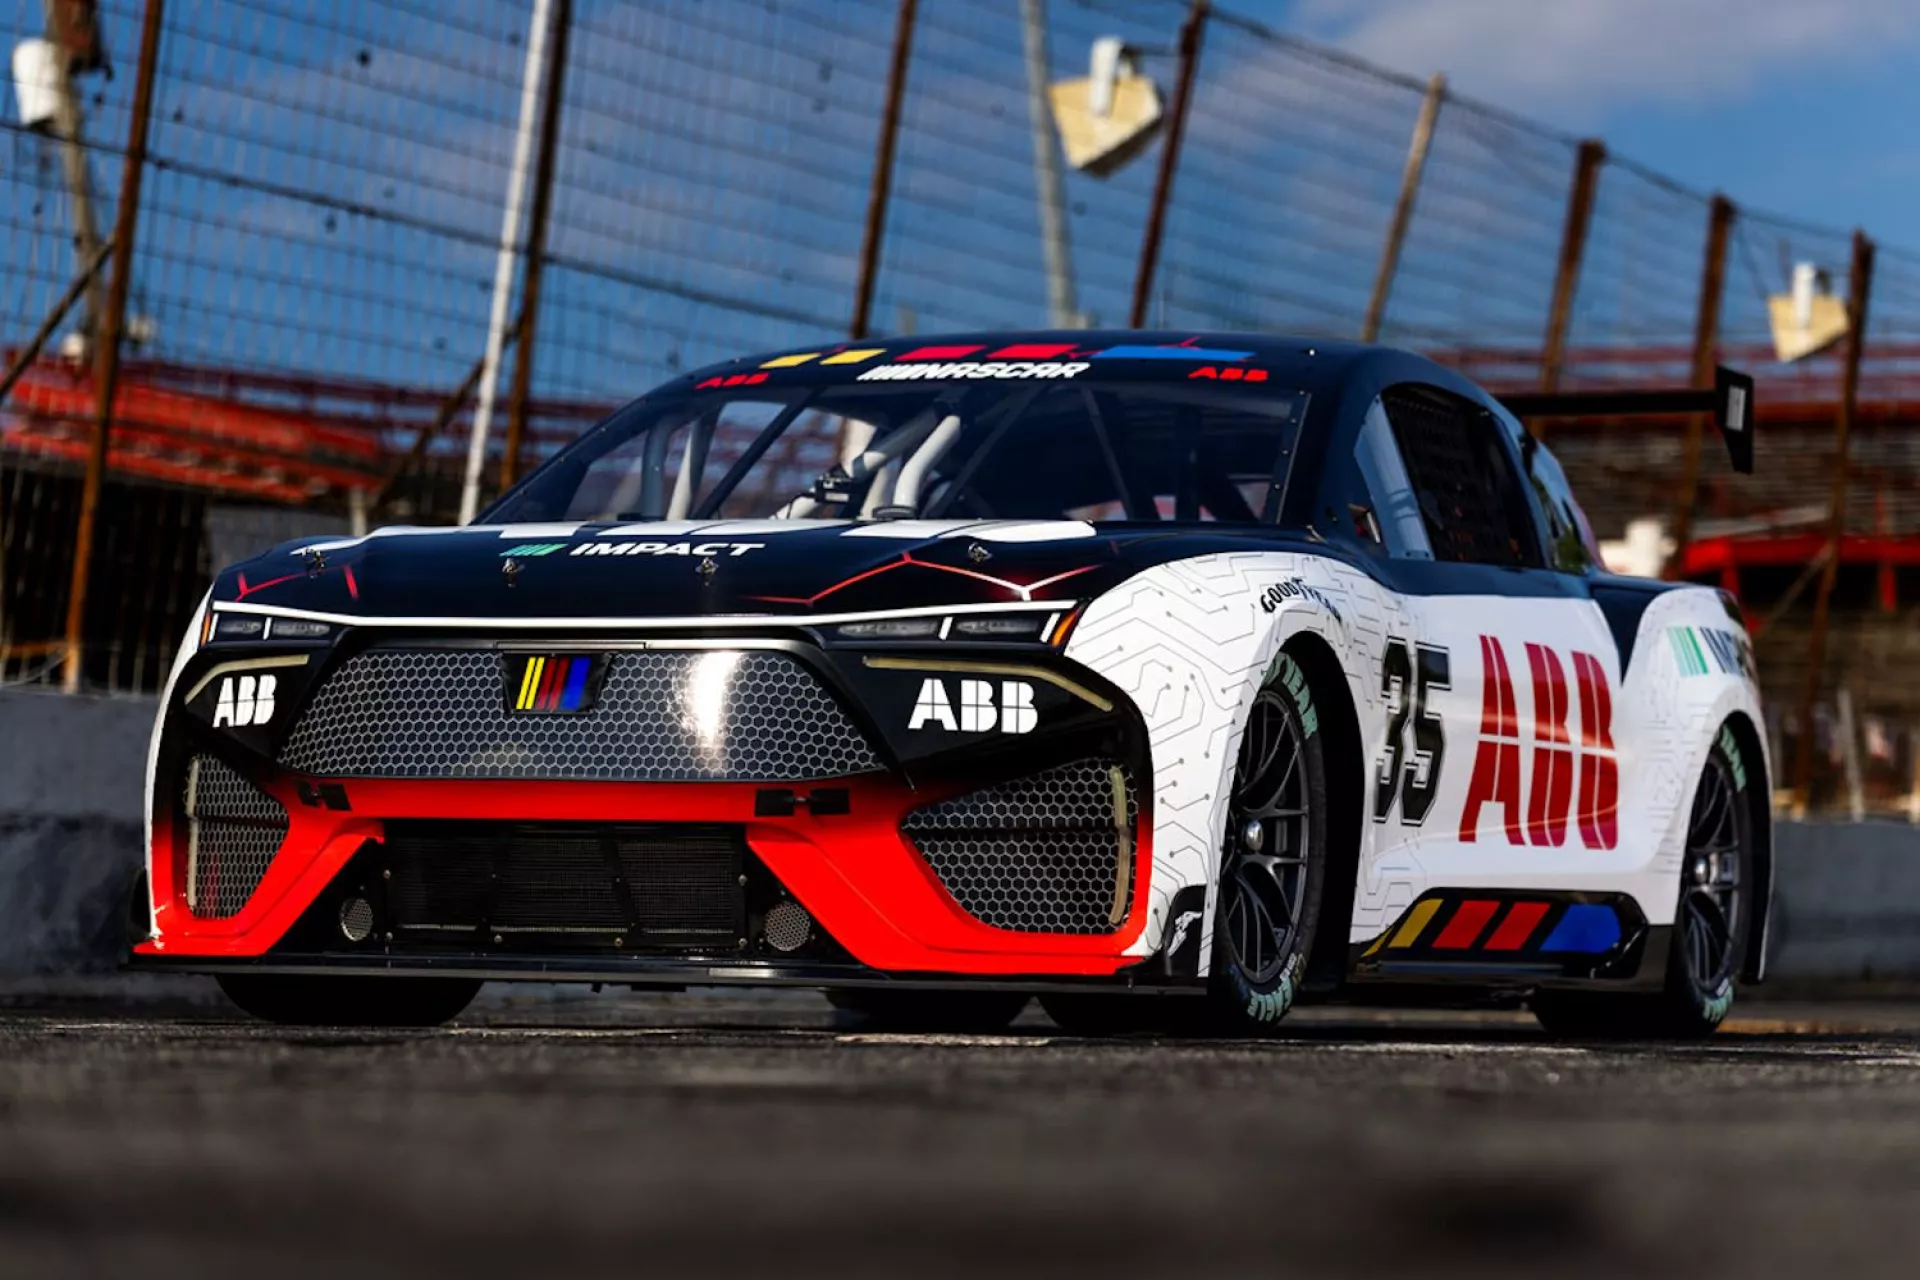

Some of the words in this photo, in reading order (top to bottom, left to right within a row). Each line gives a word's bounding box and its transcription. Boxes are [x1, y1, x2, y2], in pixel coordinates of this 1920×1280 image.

[696, 371, 771, 389] ABB
[896, 361, 1092, 380] NASCAR
[1188, 366, 1269, 382] ABB
[569, 542, 766, 557] IMPACT
[212, 674, 277, 728] ABB
[908, 678, 1038, 734] ABB
[1372, 635, 1453, 827] 35
[1459, 633, 1619, 851] ABB
